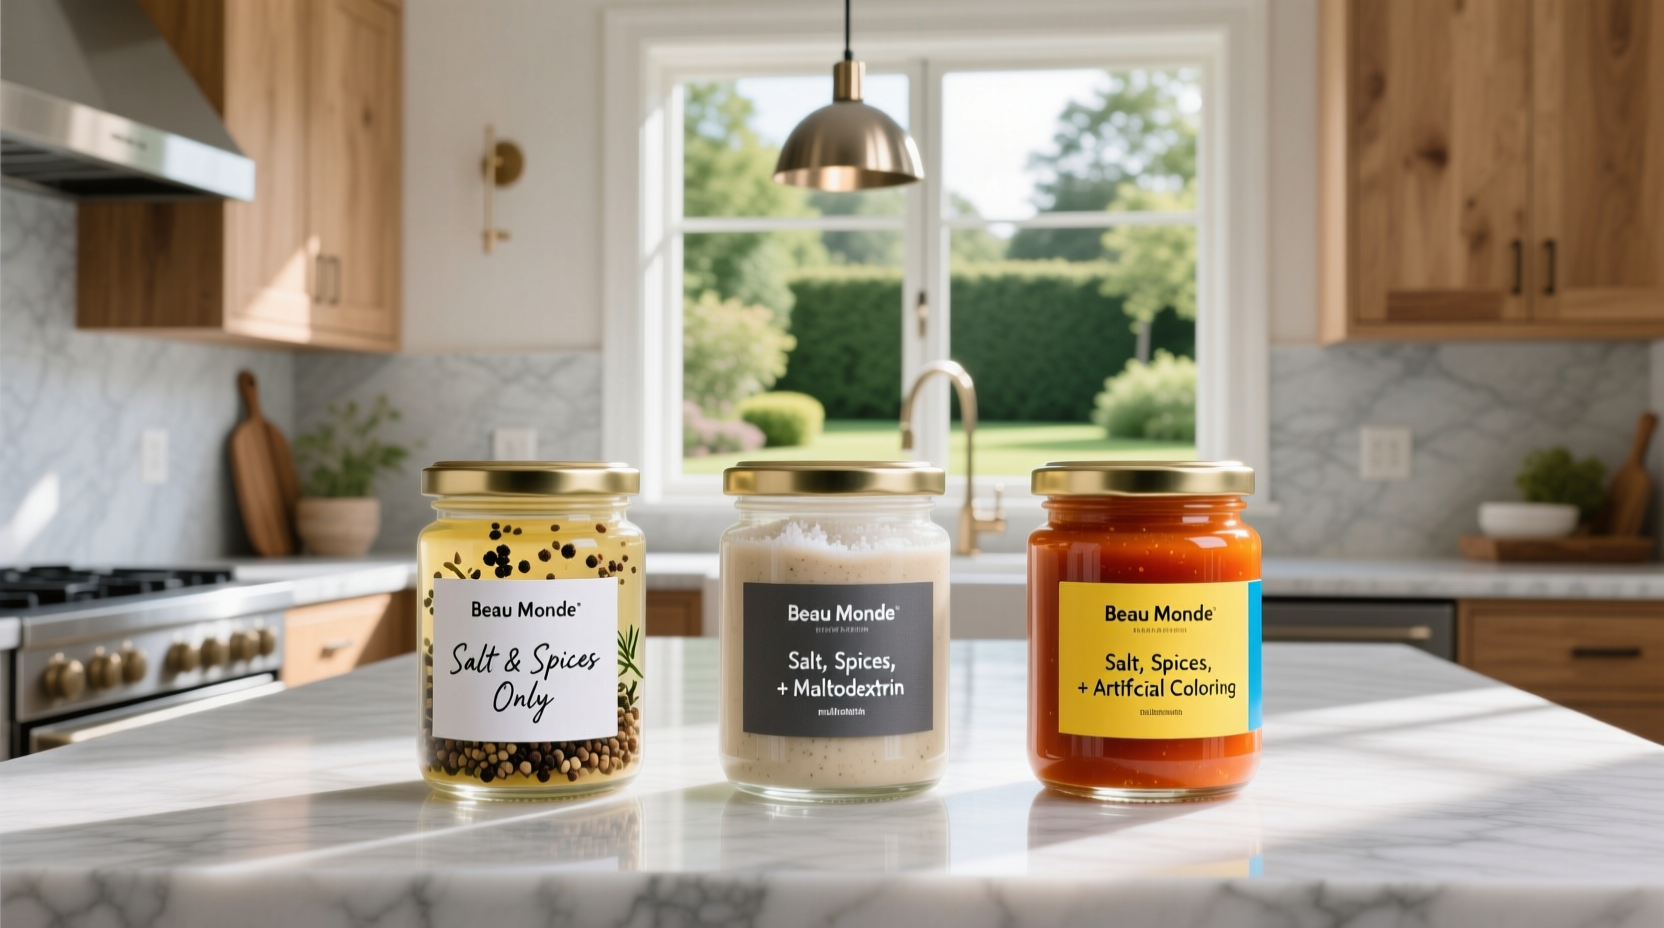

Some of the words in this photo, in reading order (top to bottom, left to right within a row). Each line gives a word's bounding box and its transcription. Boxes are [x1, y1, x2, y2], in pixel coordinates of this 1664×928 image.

[471, 600, 512, 617] Beau
[518, 600, 577, 617] Monde
[788, 604, 831, 621] Beau
[835, 603, 895, 621] Monde
[1105, 605, 1149, 621] Beau
[1154, 604, 1213, 621] Monde
[450, 642, 500, 675] Salt
[504, 647, 521, 672] &
[530, 642, 601, 681] Spices
[788, 650, 828, 673] Salt,
[834, 651, 896, 676] Spices,
[1105, 652, 1144, 674] Salt,
[1151, 653, 1212, 675] Spices,
[777, 682, 788, 695] +
[793, 677, 905, 697] Maltodextrin
[1077, 682, 1088, 694] +
[1170, 678, 1236, 698] Coloring
[493, 680, 554, 724] Only
